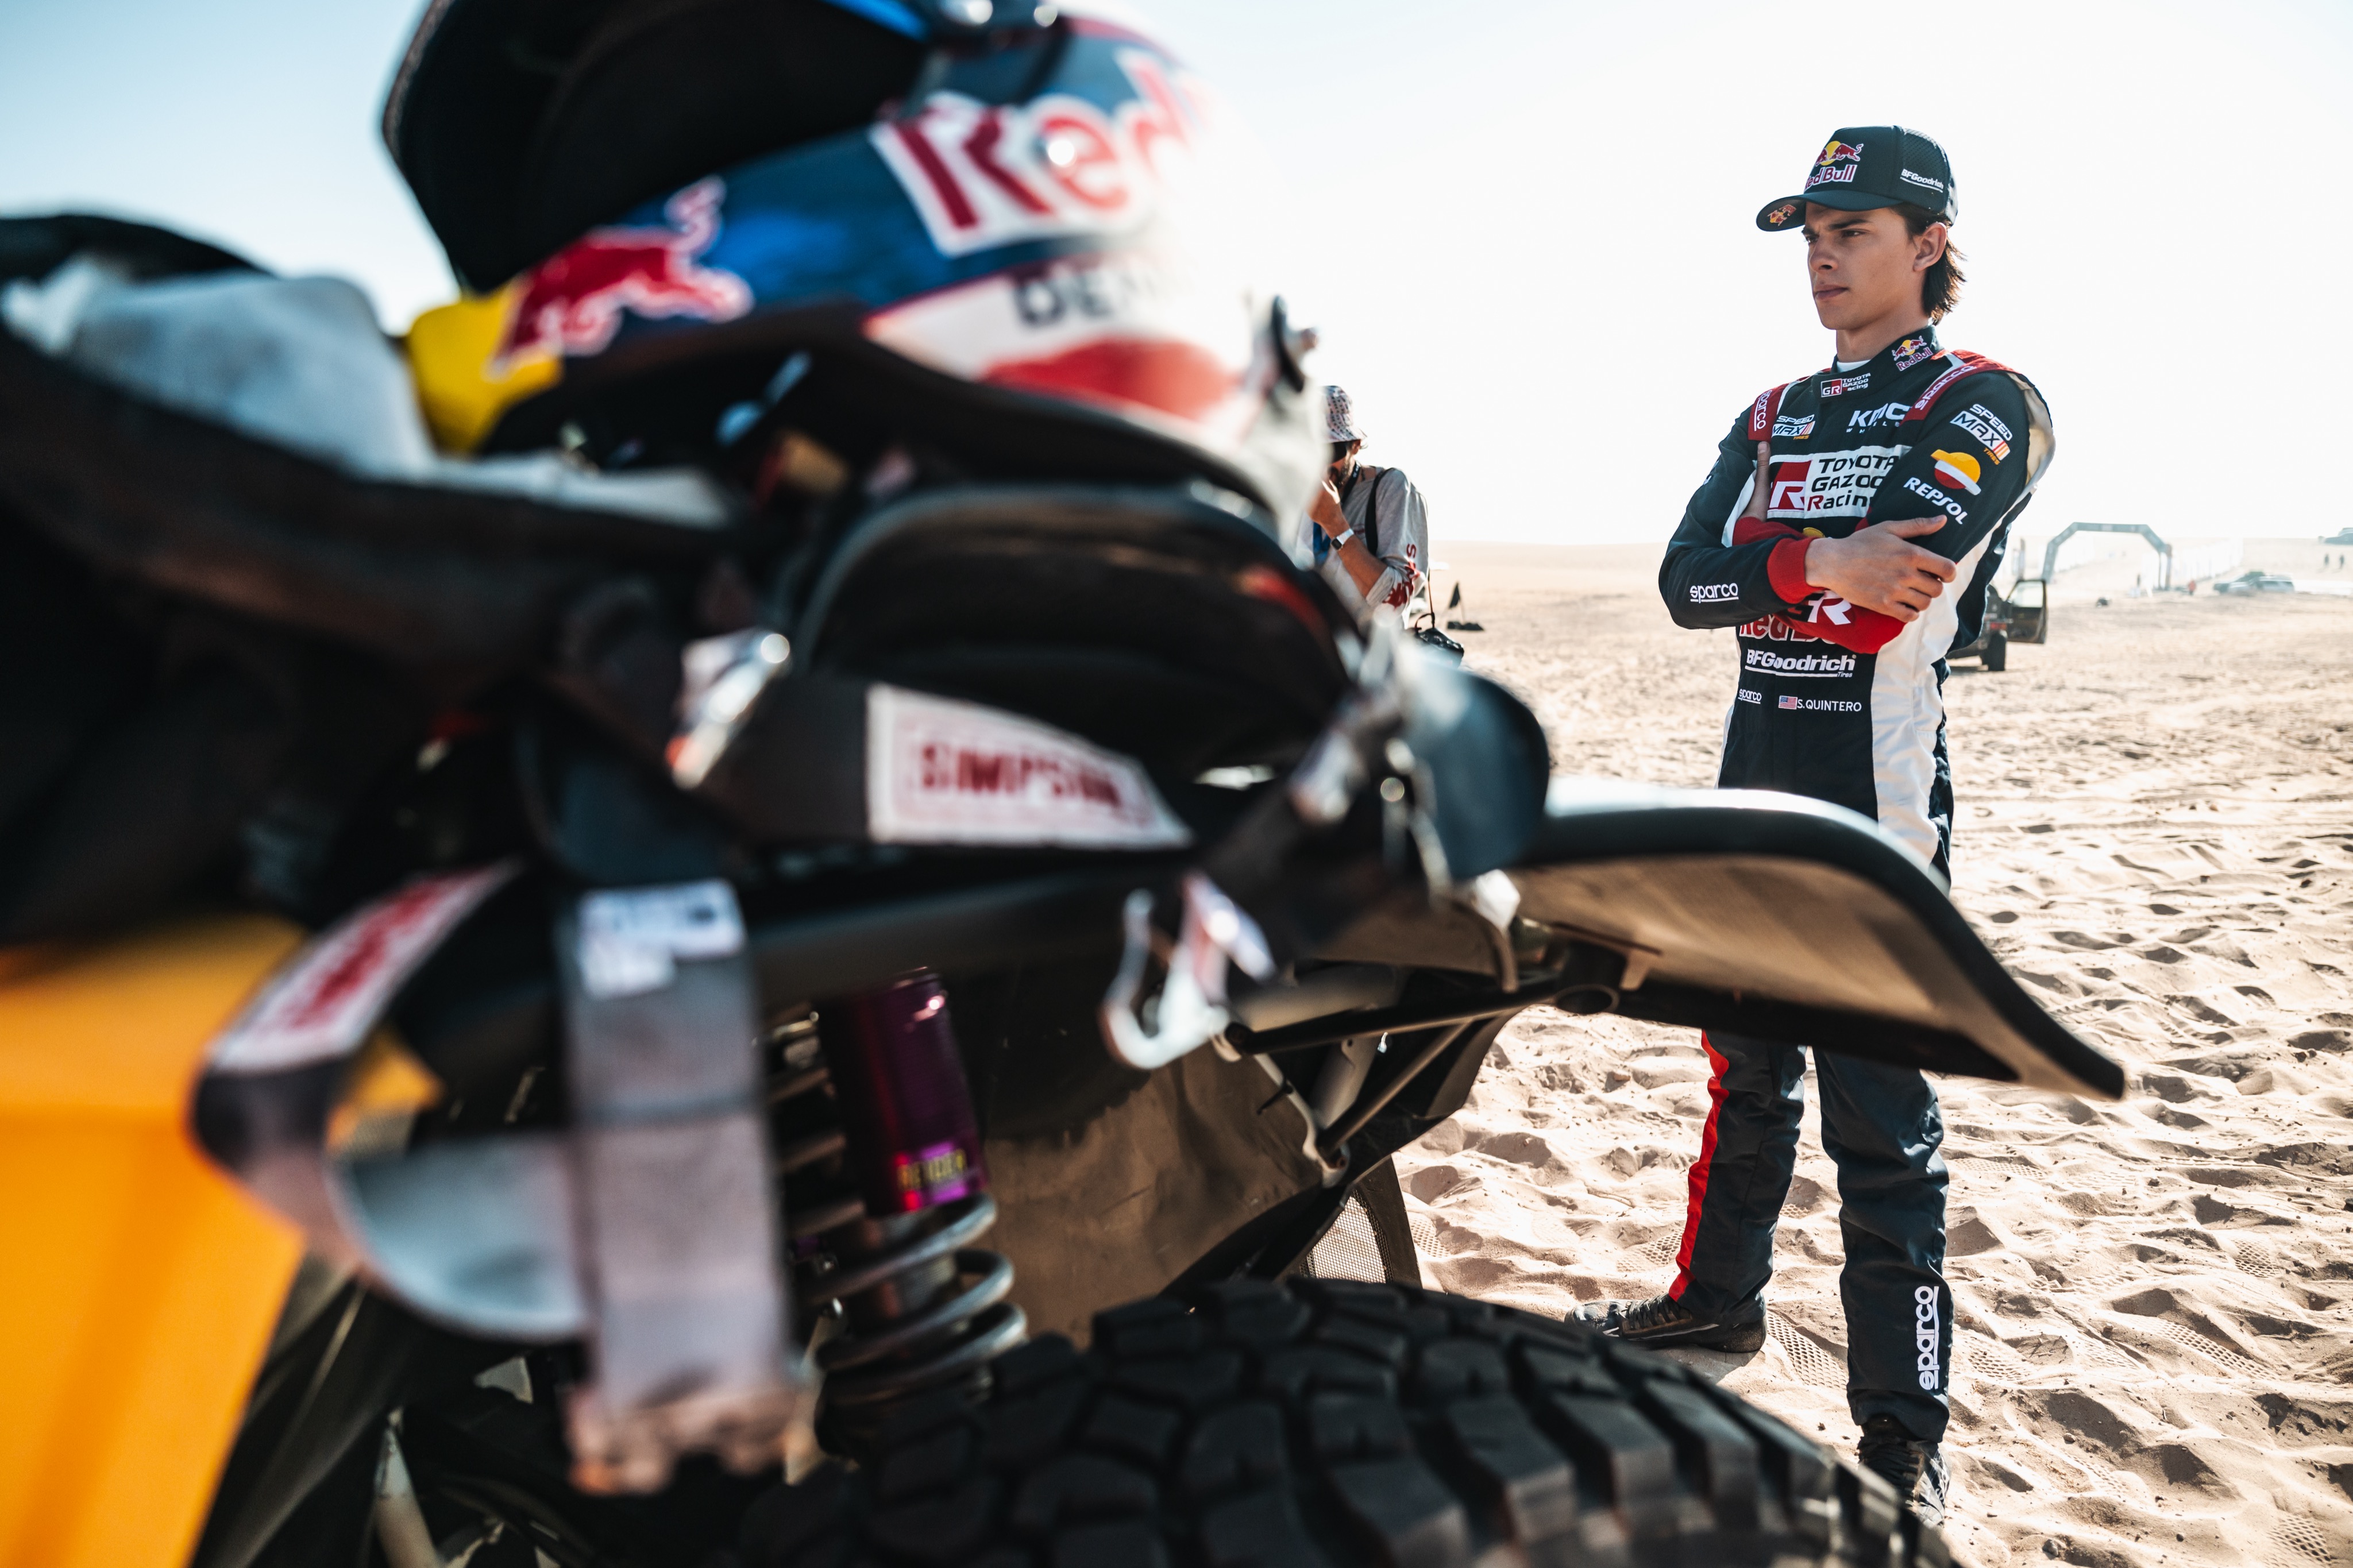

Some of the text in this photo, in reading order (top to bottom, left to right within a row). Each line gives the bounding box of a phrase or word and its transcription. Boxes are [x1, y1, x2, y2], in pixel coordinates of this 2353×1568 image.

[1822, 164, 1858, 183] Bull
[1900, 168, 1944, 190] BFGoodrich
[1896, 346, 1934, 372] Red Bull
[1842, 372, 1871, 383] TOYOTA
[1842, 378, 1869, 388] GAZOO
[1822, 385, 1841, 396] GR
[1915, 365, 1977, 411] sparco
[1776, 414, 1815, 425] SPEED
[1969, 403, 2013, 441] SPEED
[1773, 425, 1804, 435] MAX
[1954, 413, 2000, 447] MAX
[1983, 447, 2001, 465] TIRES
[1903, 477, 1968, 524] REPSOL
[1689, 582, 1739, 604] sparco
[1746, 648, 1856, 671] BFGoodrich
[1738, 688, 1762, 704] sparco
[1797, 699, 1862, 712] S.QUINTERO
[1914, 1285, 1940, 1391] sparco
